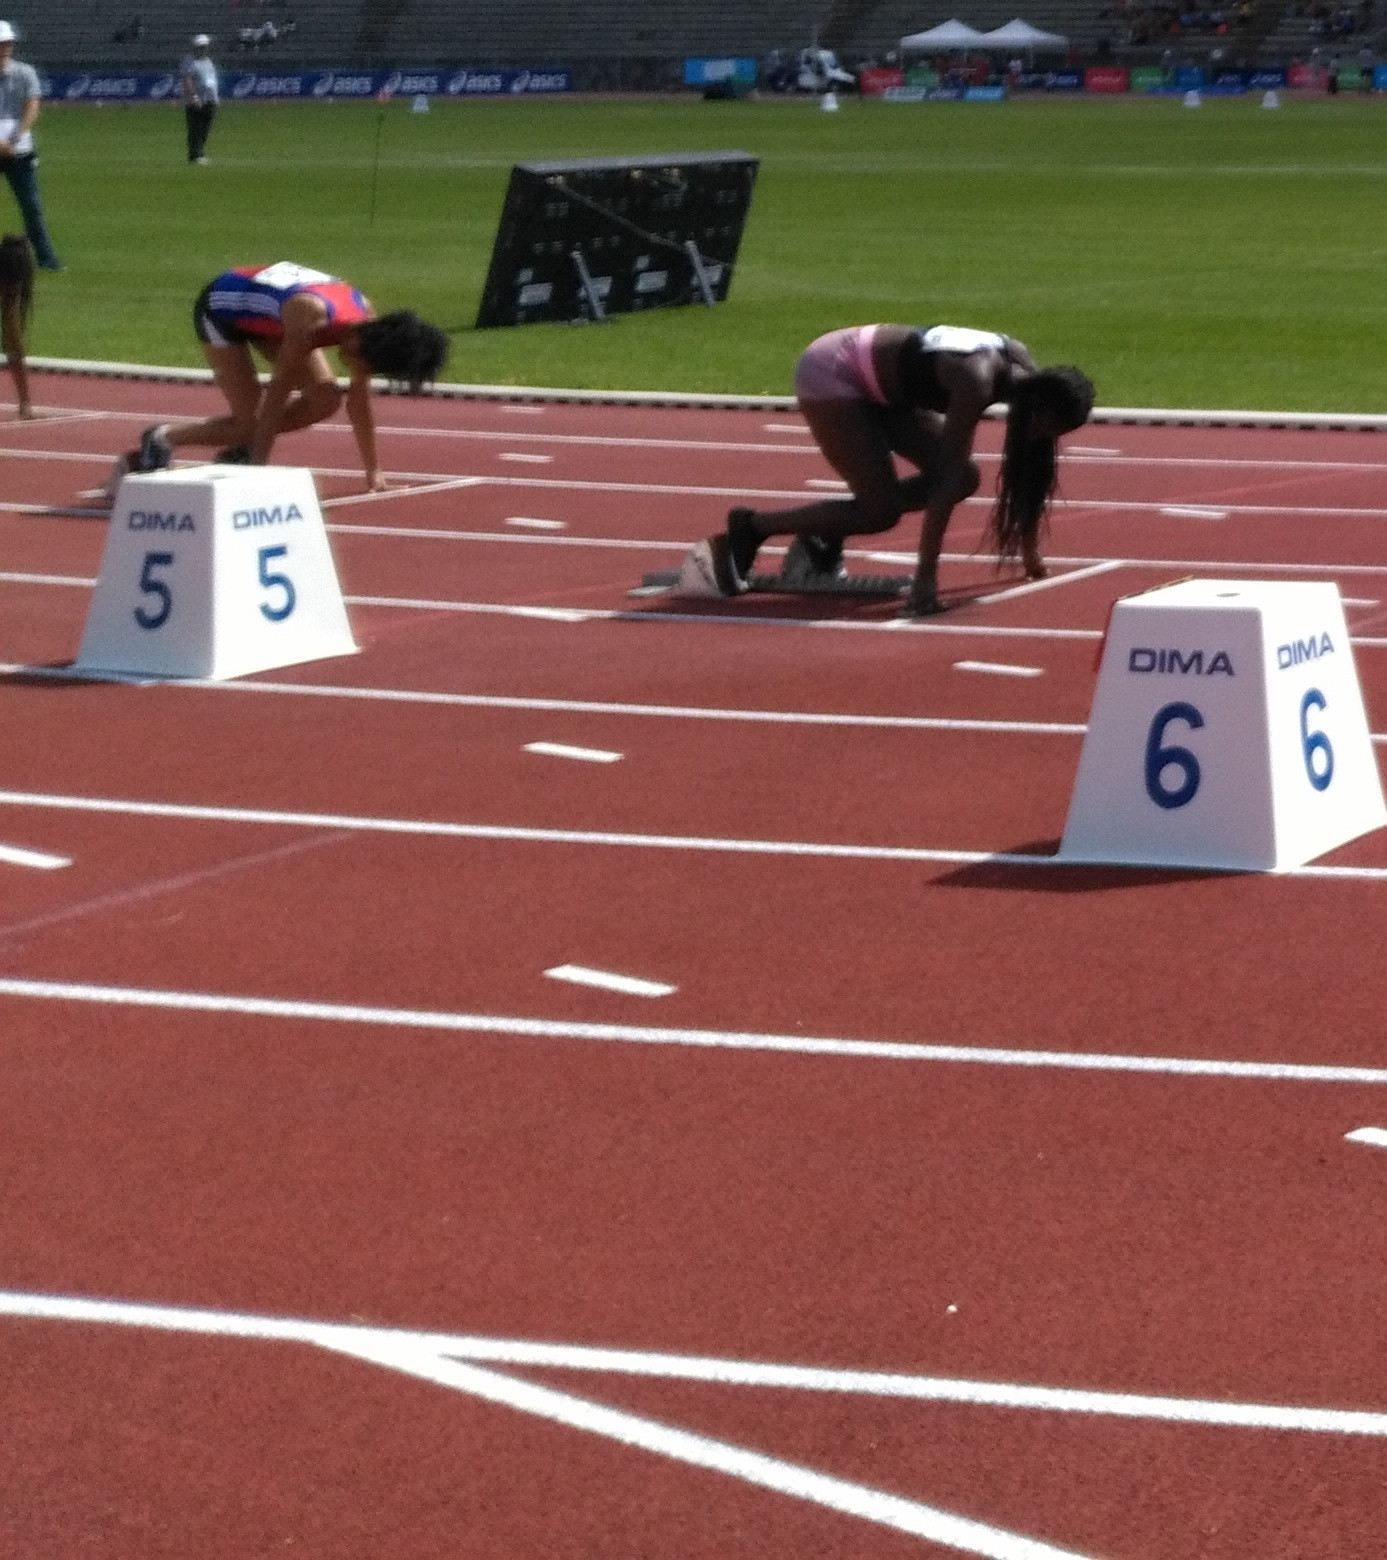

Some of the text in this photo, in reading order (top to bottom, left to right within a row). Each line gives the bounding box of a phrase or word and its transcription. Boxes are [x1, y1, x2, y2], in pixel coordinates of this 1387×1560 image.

[127, 509, 196, 533] DIMA
[232, 503, 304, 531] DIMA
[133, 550, 175, 630] 5
[258, 543, 298, 622] 5
[1128, 647, 1236, 677] DIMA
[1276, 631, 1336, 671] DIMA
[1144, 700, 1205, 811] 6
[1299, 687, 1336, 792] 6
